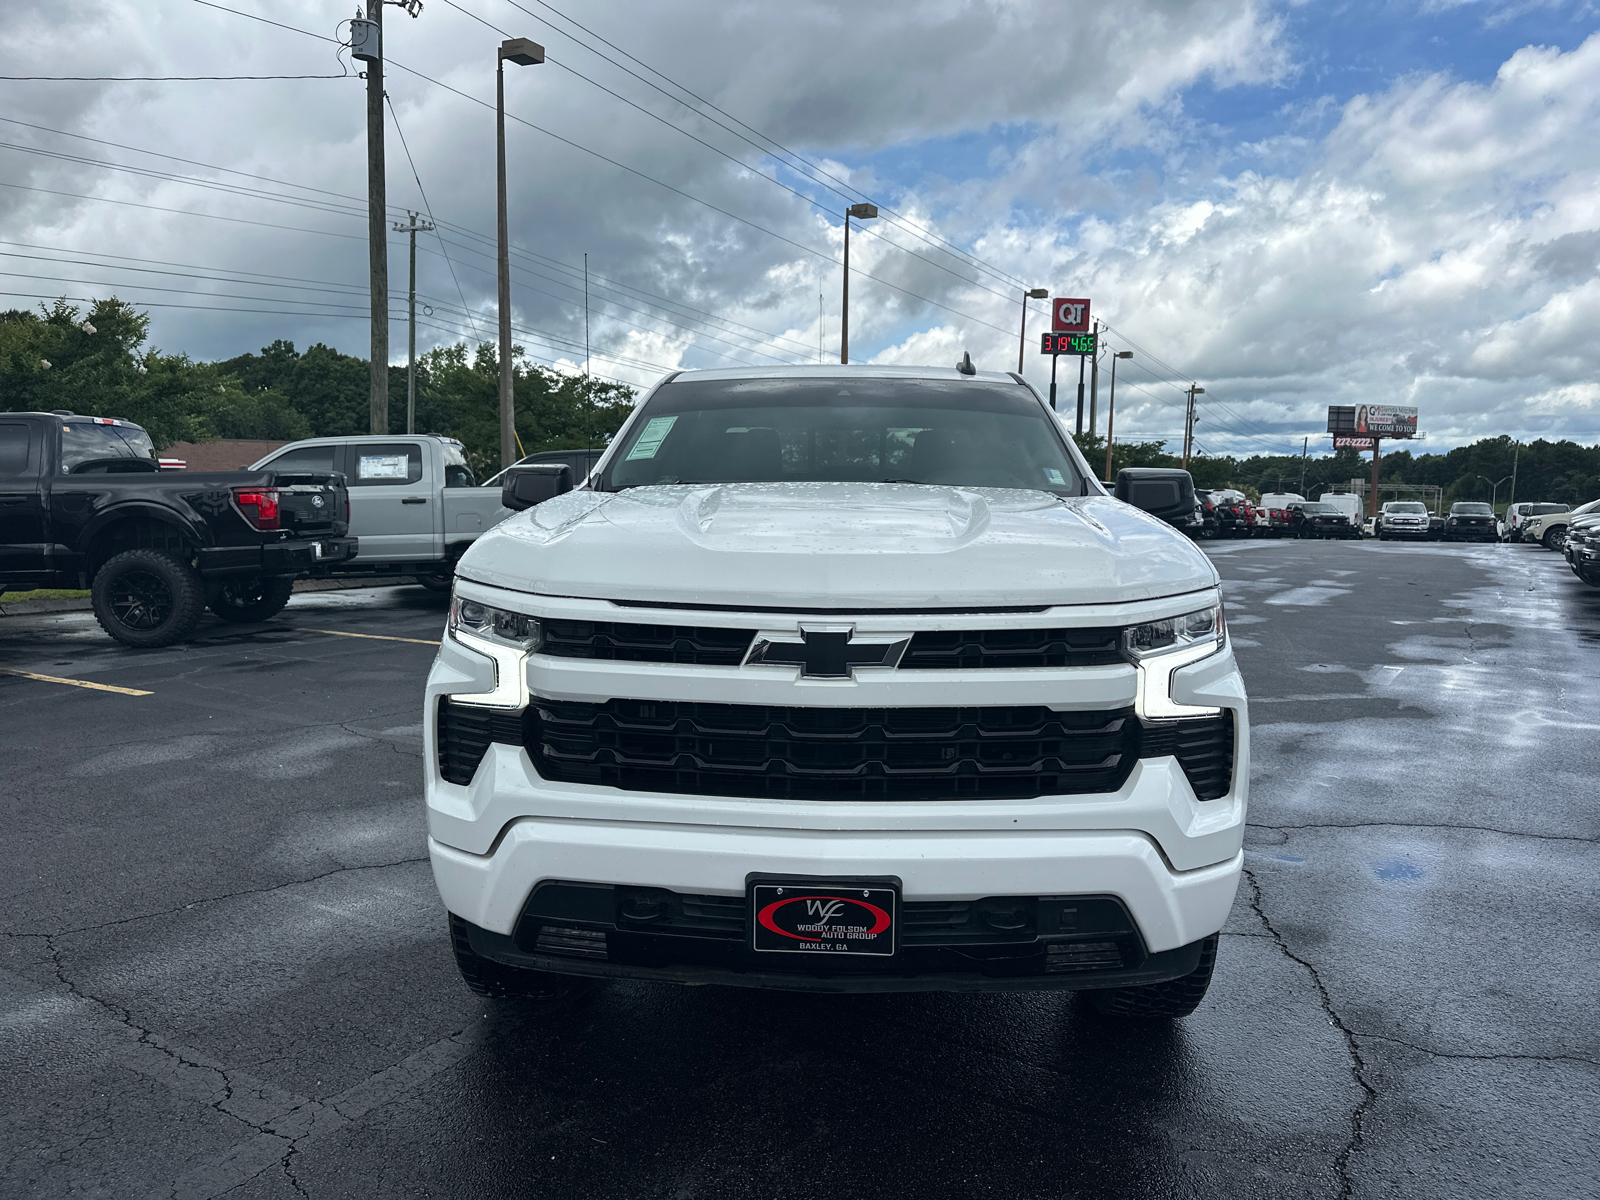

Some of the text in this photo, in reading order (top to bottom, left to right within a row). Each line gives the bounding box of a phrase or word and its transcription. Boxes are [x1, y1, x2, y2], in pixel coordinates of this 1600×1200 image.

[1059, 303, 1086, 325] QT
[1378, 424, 1394, 432] COME
[797, 924, 867, 933] WOODY FOLSOM
[821, 931, 877, 940] AUTO GROUP
[799, 942, 848, 951] BAXLEY, GA
